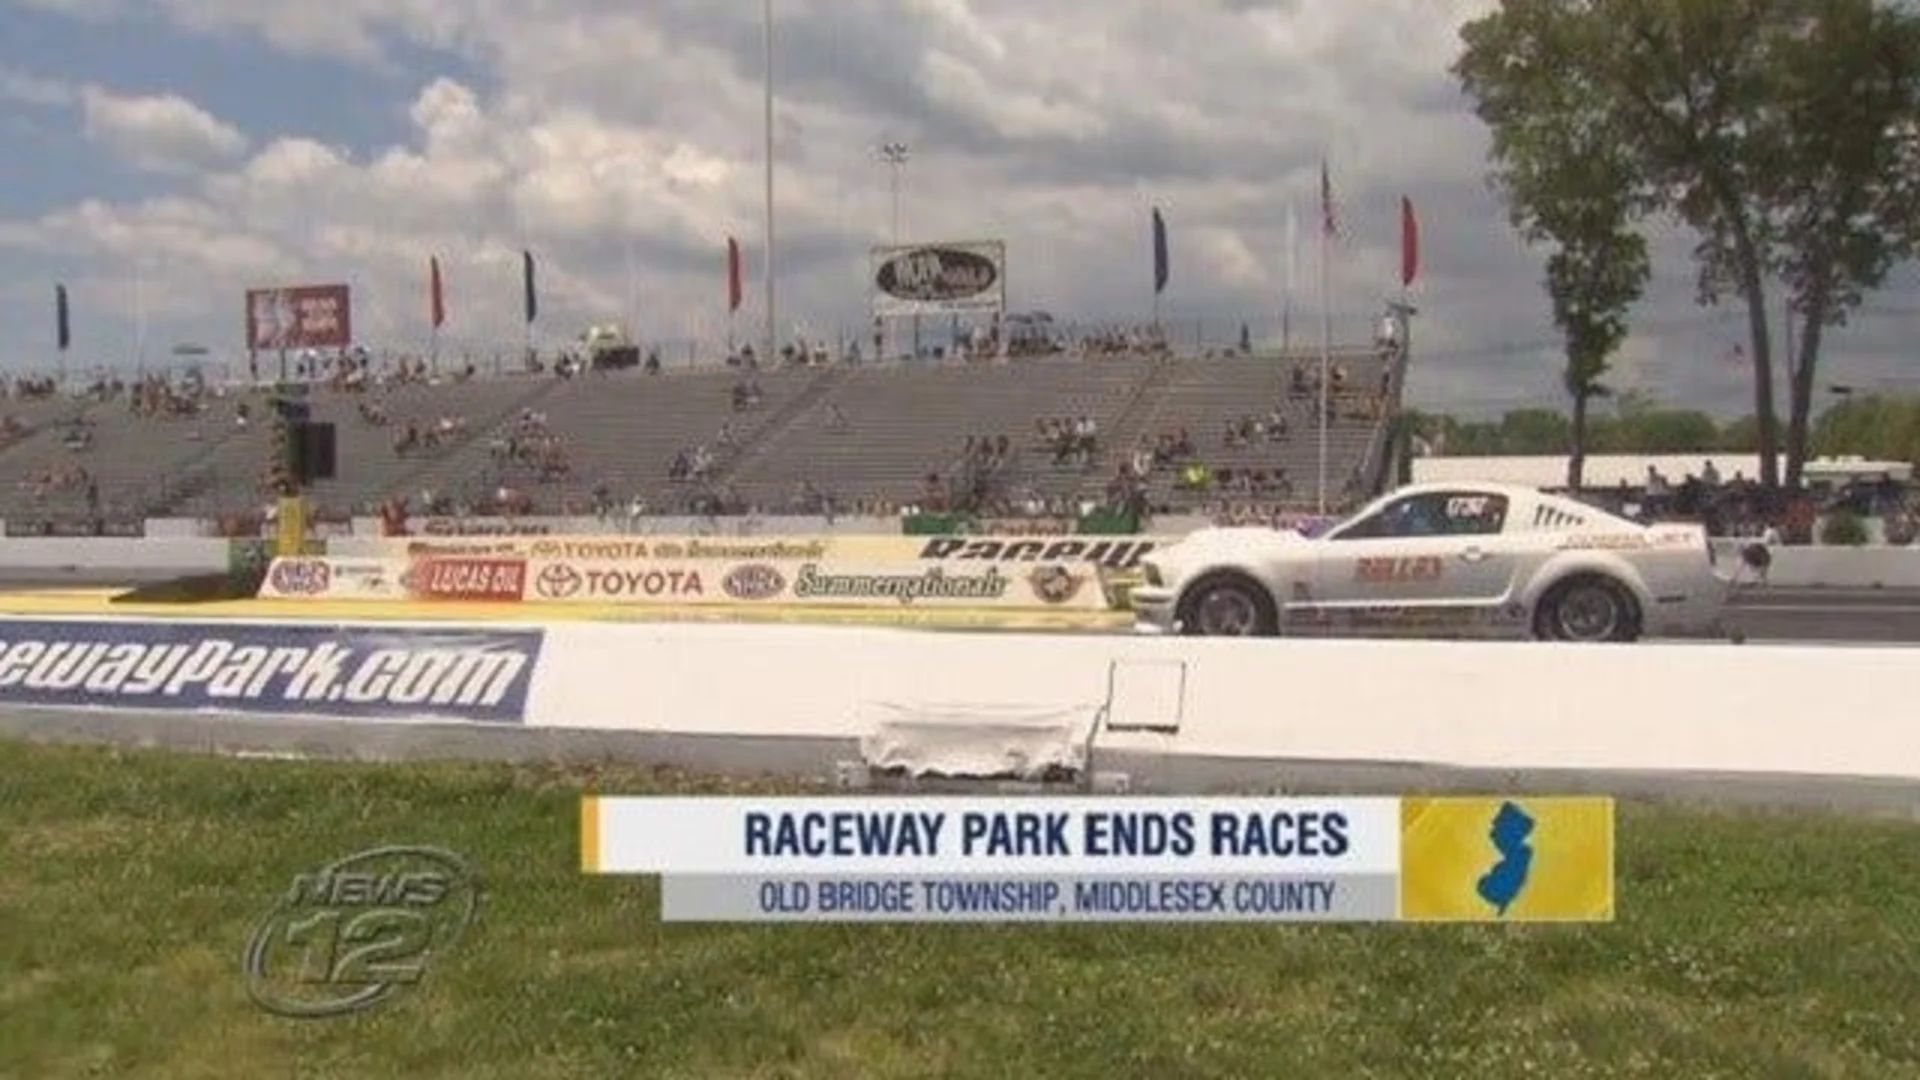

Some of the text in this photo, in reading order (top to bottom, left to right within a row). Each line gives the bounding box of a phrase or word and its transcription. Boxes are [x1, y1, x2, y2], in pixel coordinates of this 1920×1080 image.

[431, 564, 521, 593] LUCAS OIL
[586, 570, 704, 596] TOYOTA
[794, 564, 1006, 604] Summernationals
